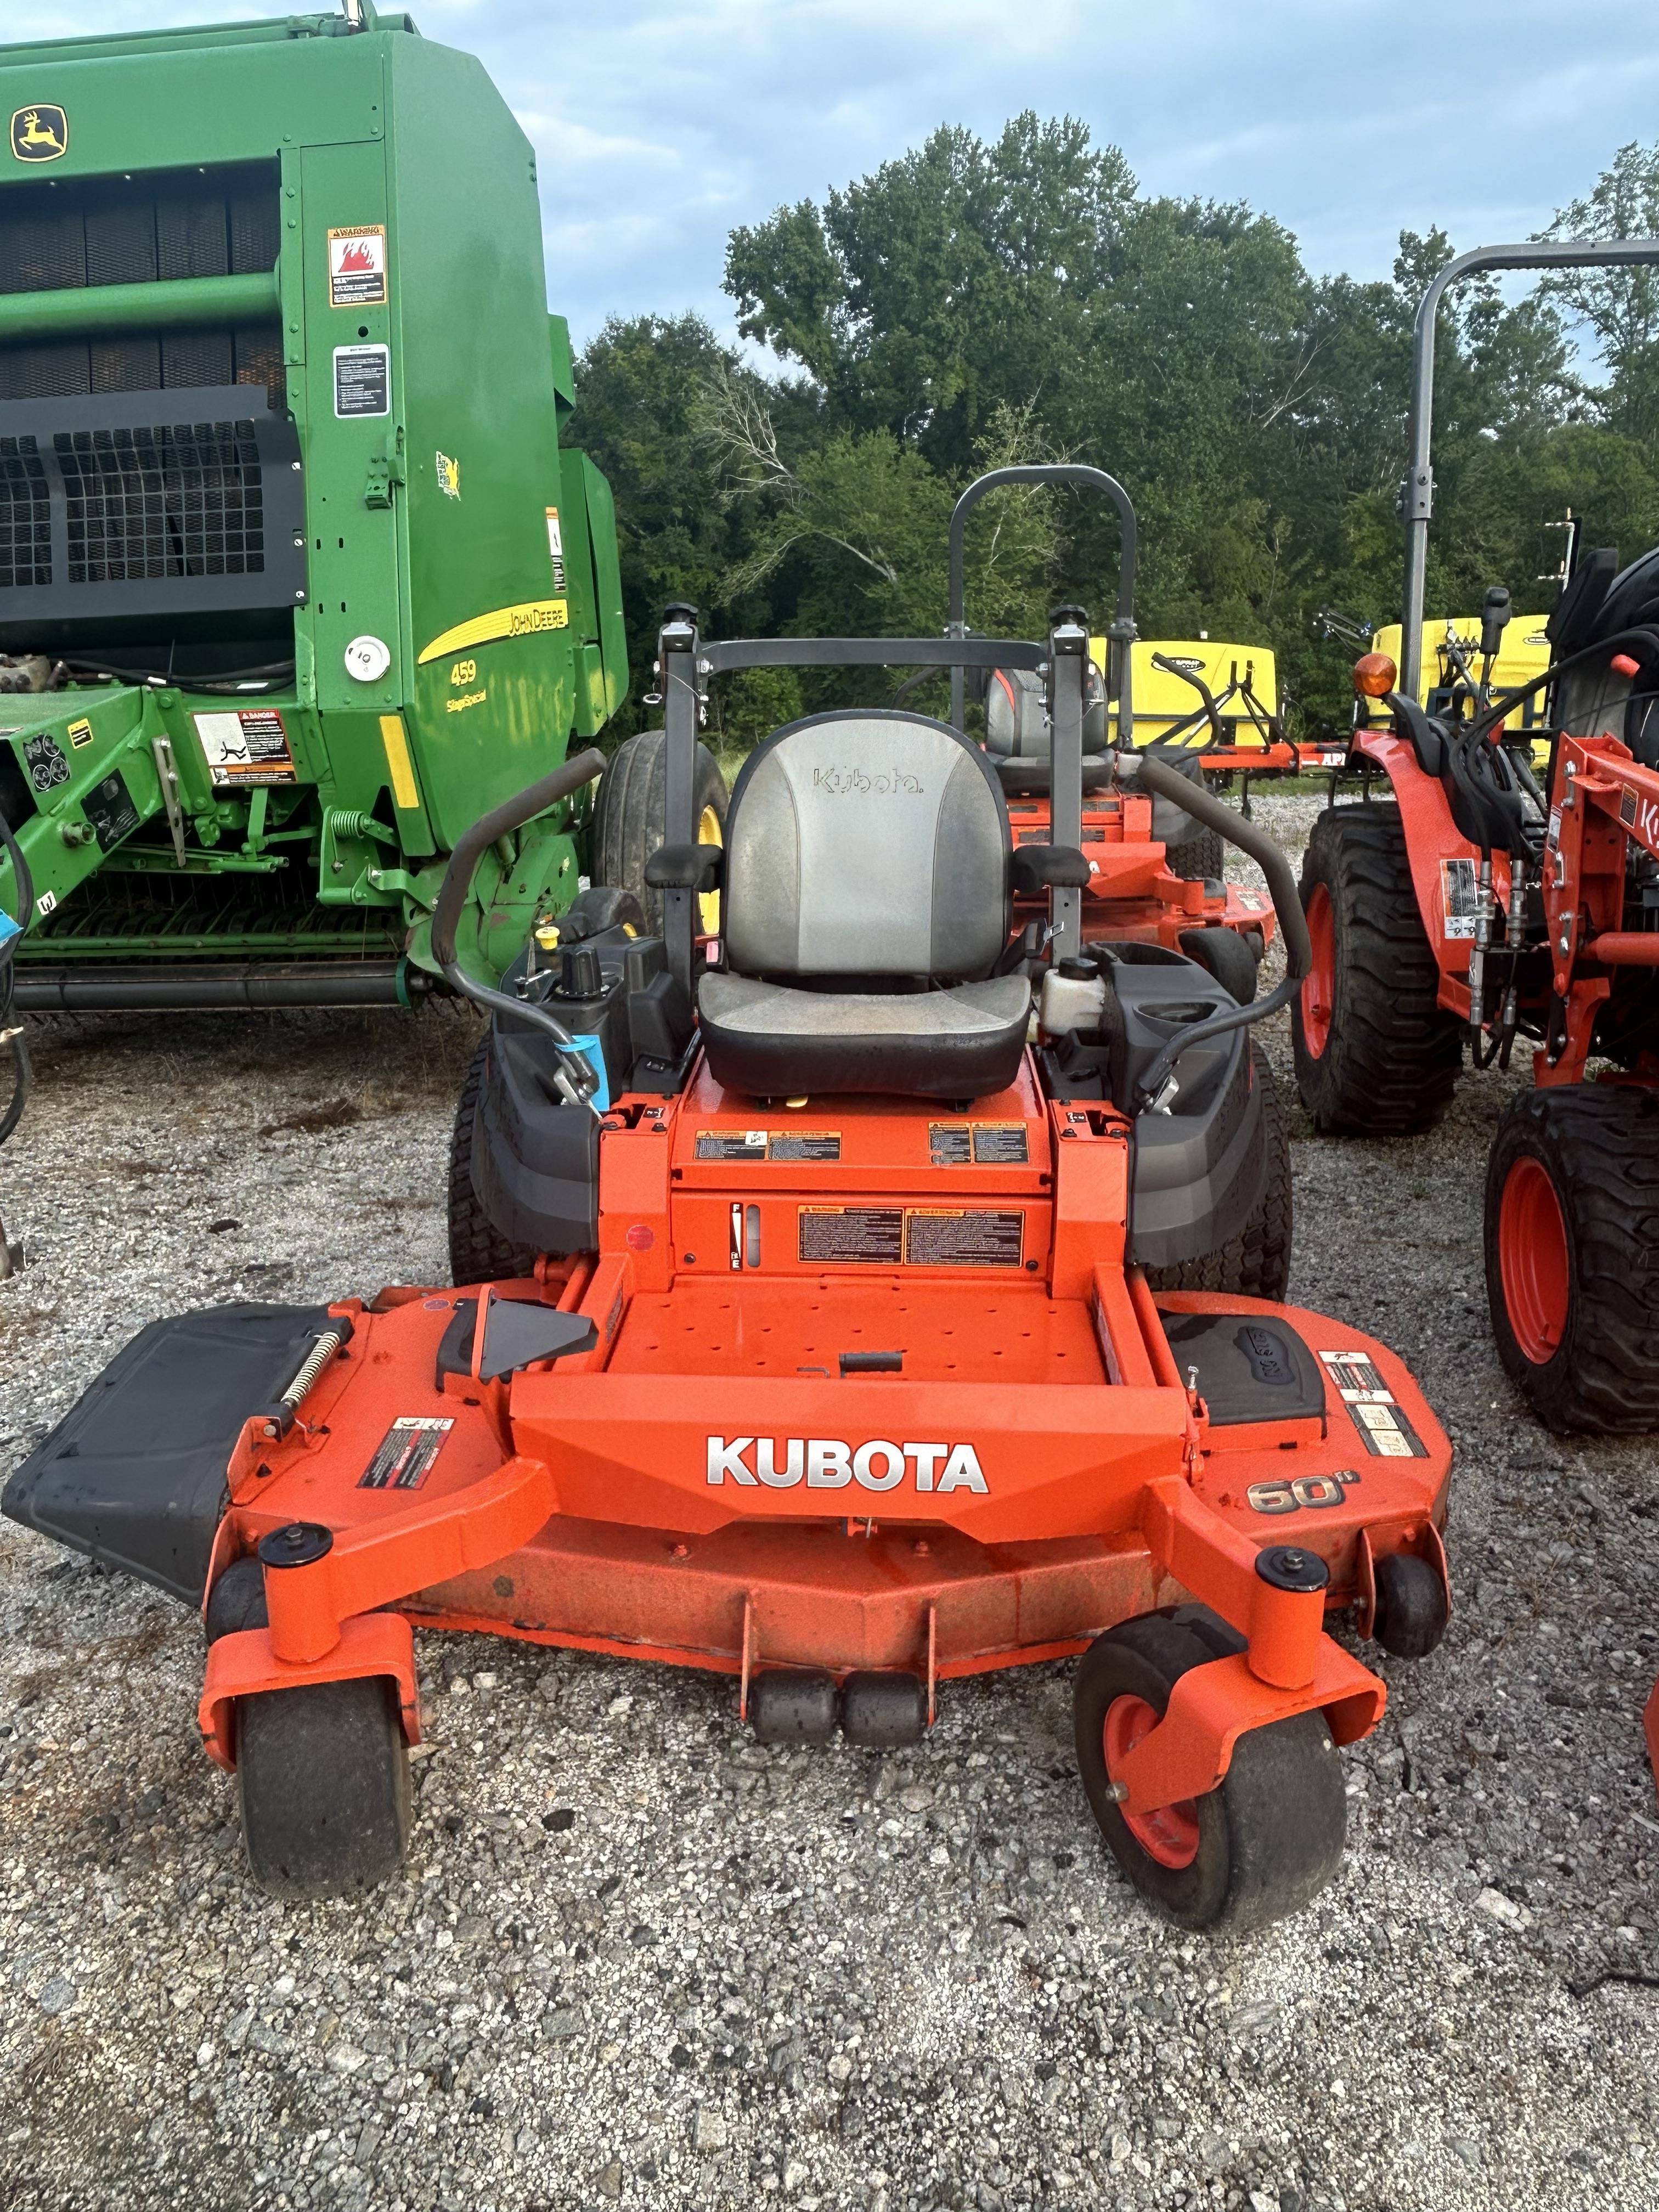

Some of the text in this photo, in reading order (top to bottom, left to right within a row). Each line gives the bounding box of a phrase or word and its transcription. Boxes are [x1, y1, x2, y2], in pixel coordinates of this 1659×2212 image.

[509, 609, 564, 634] JOHN DEERE
[451, 659, 476, 686] 459
[733, 1204, 740, 1212] F
[732, 1260, 740, 1268] E
[707, 1436, 990, 1494] KUBOTA
